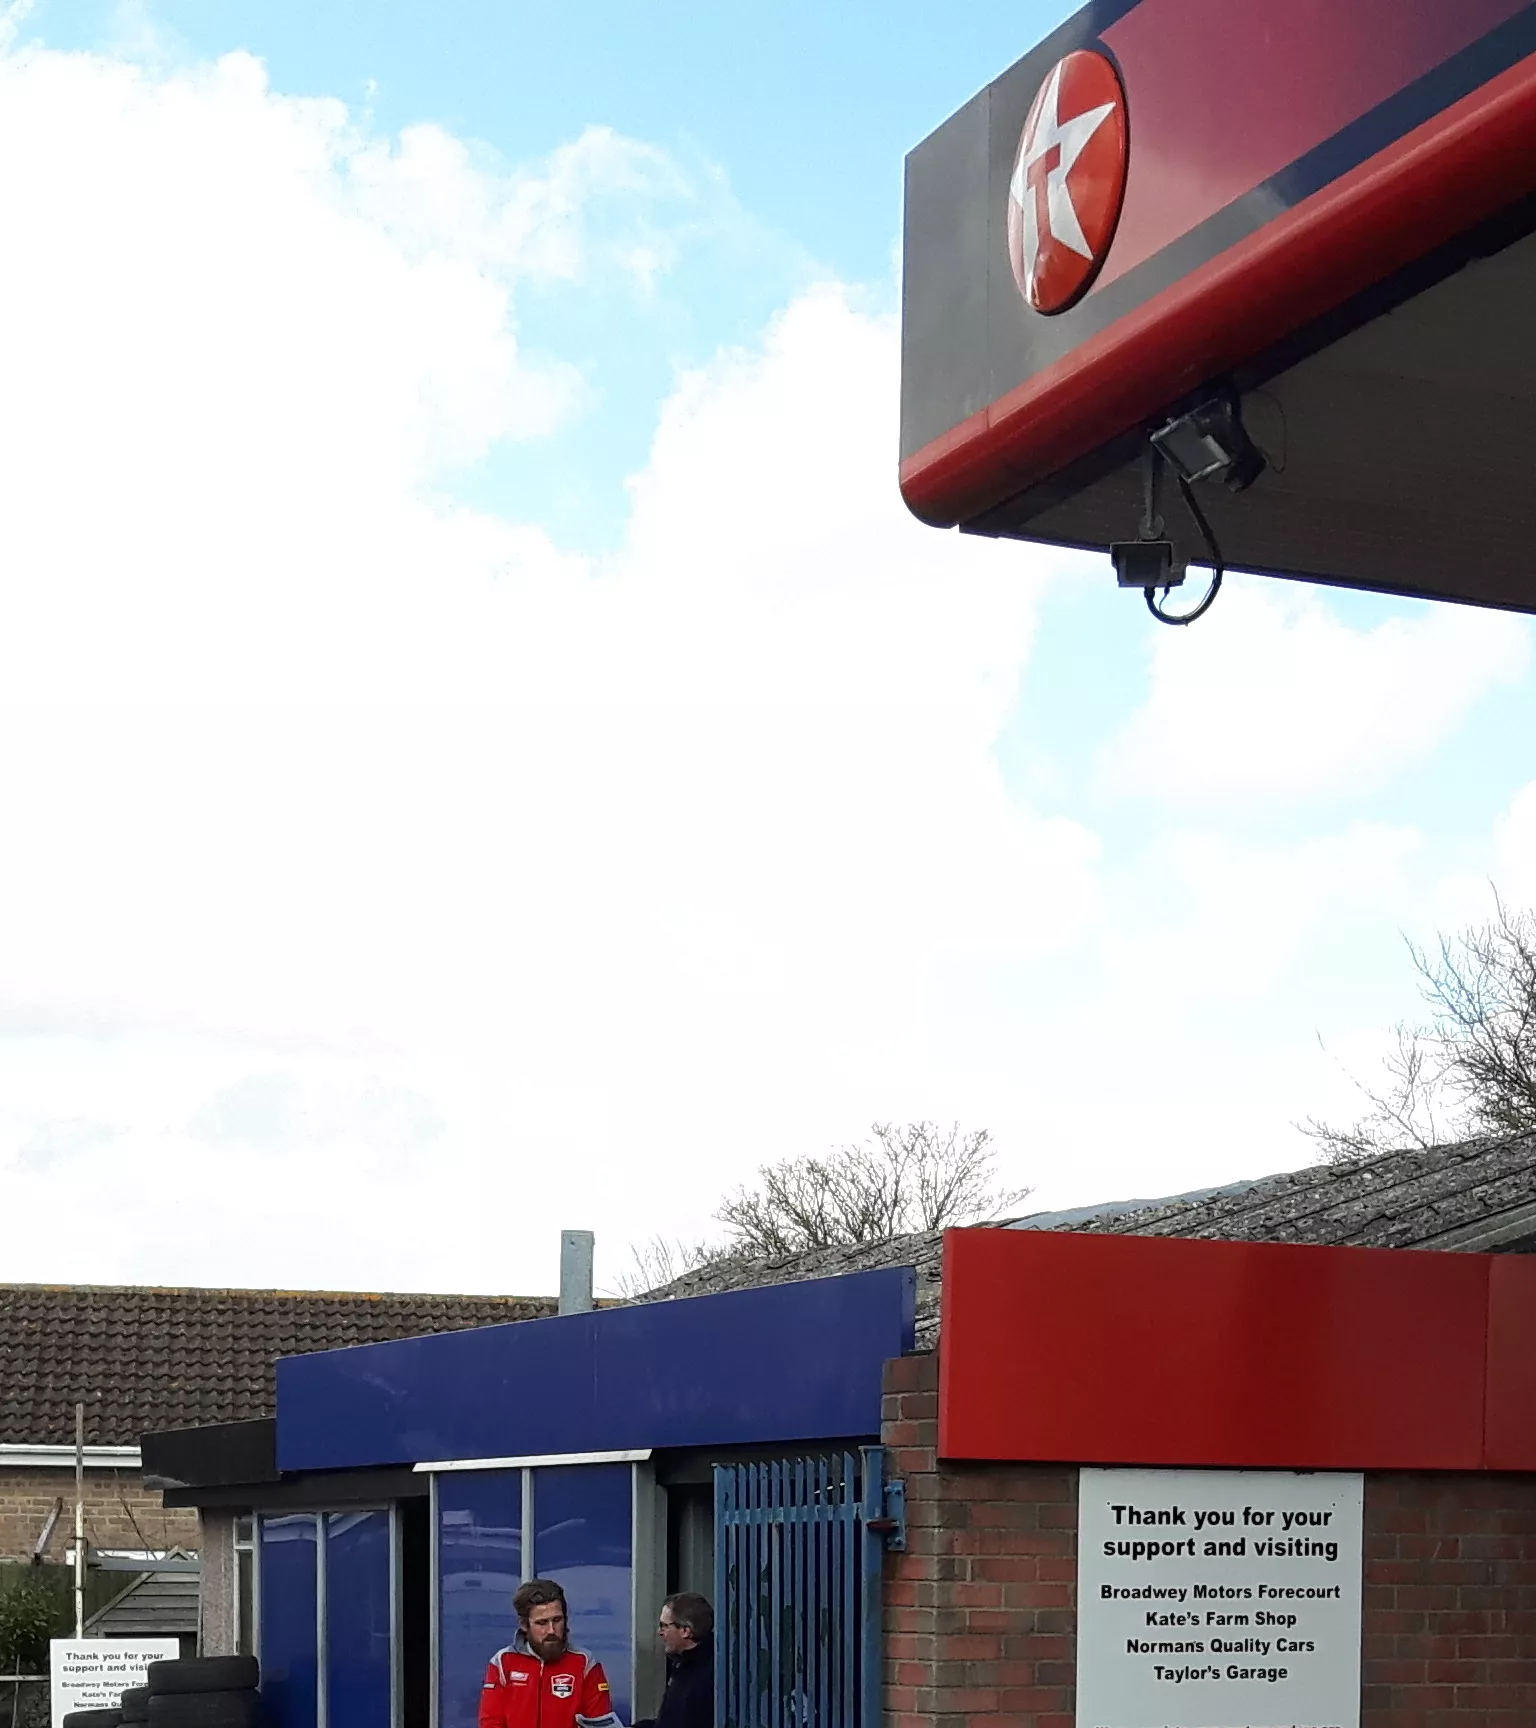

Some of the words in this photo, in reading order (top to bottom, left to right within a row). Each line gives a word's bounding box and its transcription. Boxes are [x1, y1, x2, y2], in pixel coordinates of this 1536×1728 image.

[1111, 1506, 1186, 1525] Thank
[1193, 1511, 1235, 1530] you
[1243, 1506, 1275, 1525] for
[1282, 1511, 1332, 1531] your
[1104, 1538, 1195, 1560] support
[1203, 1537, 1246, 1556] and
[1254, 1537, 1338, 1561] visiting
[1101, 1585, 1187, 1602] Broadwey
[1193, 1585, 1252, 1599] Motors
[1258, 1584, 1341, 1599] Forecourt
[1146, 1611, 1200, 1626] Kate's
[1206, 1611, 1249, 1626] Farm
[1255, 1611, 1297, 1628] Shop
[1210, 1638, 1270, 1655] Quality
[1276, 1638, 1315, 1652] Cars
[66, 1652, 99, 1661] Thank
[102, 1653, 121, 1662] you
[124, 1652, 138, 1660] for
[141, 1653, 164, 1662] your
[62, 1665, 104, 1673] support
[107, 1664, 126, 1672] and
[1154, 1665, 1220, 1683] Taylor's
[1226, 1665, 1288, 1682] Garage
